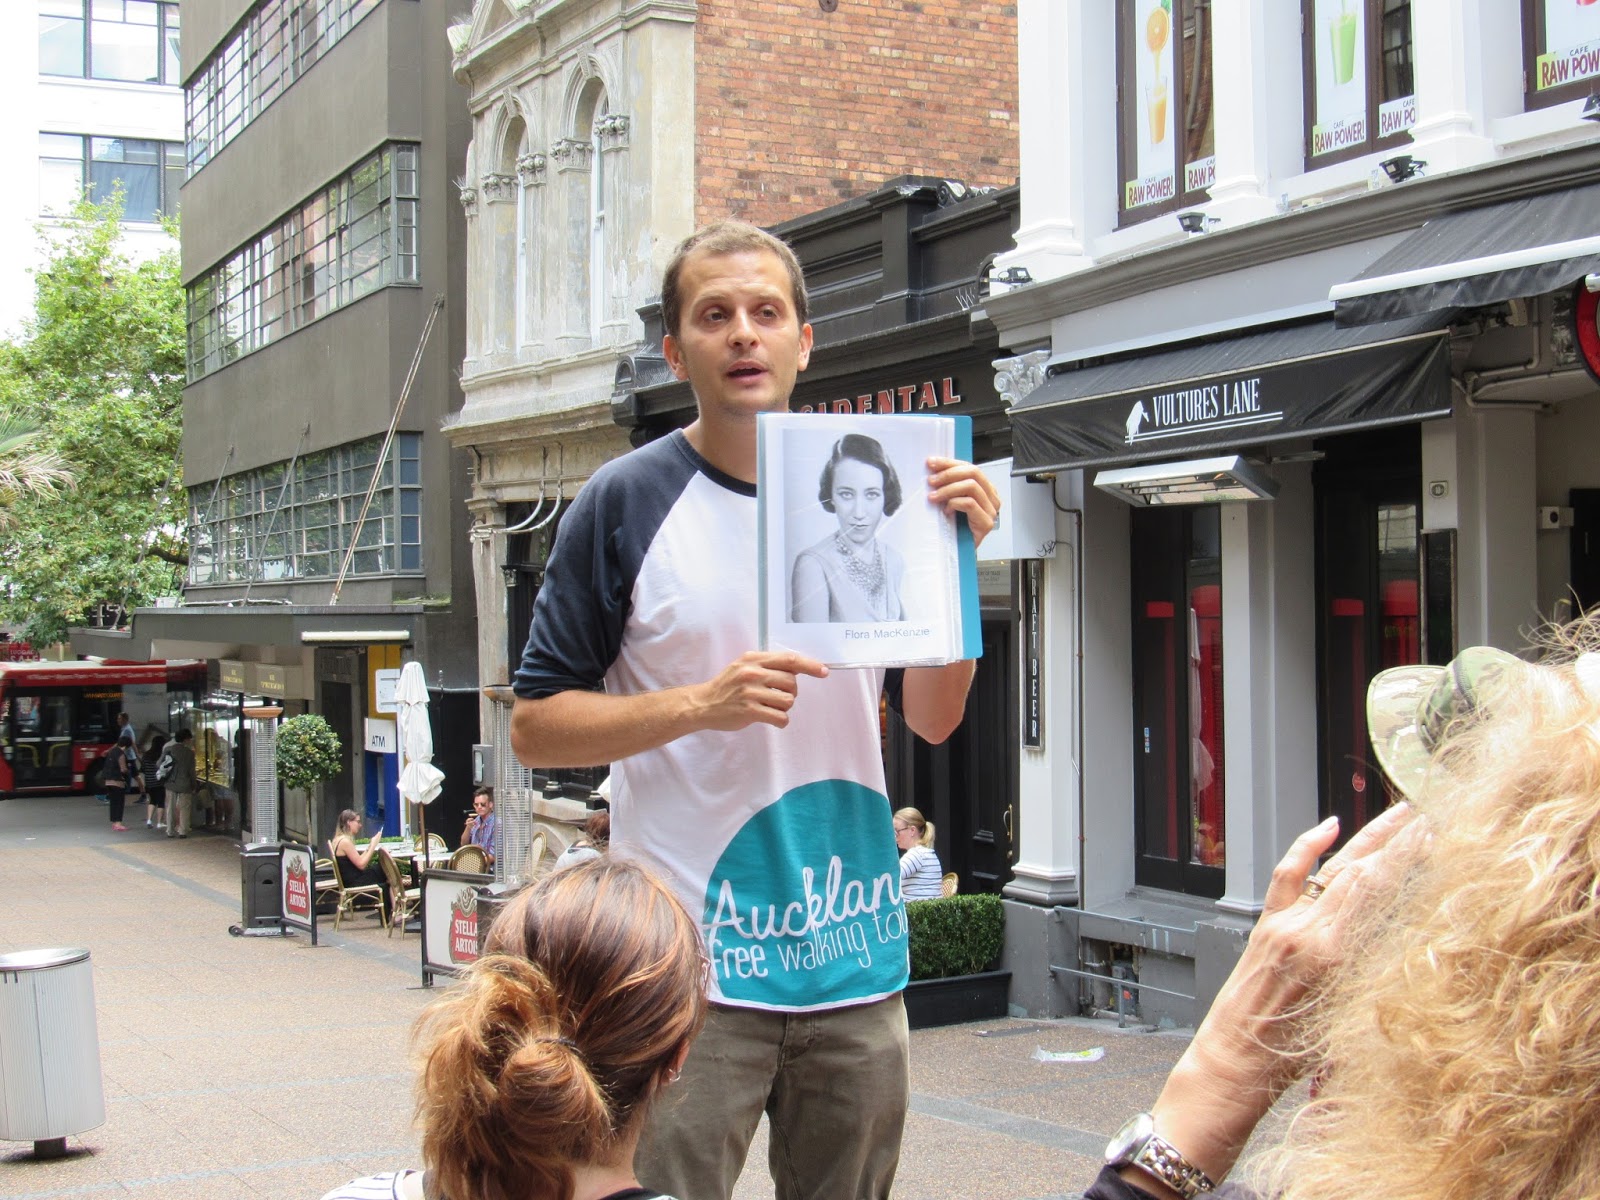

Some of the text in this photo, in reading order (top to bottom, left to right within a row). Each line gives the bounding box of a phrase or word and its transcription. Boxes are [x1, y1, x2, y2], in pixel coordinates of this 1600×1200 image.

[1570, 46, 1588, 56] CAFE
[1542, 48, 1600, 88] RAW POW
[1403, 98, 1415, 107] CAFE
[1333, 120, 1344, 129] CAFE
[1381, 110, 1402, 134] RAW
[1315, 119, 1365, 154] RAW POWER!
[1188, 166, 1207, 190] RAW
[1128, 175, 1173, 206] RAW POWER!
[1153, 378, 1261, 427] VULTURES LANE
[845, 627, 930, 639] Flora MacKenzie
[372, 735, 386, 748] ATM
[289, 879, 306, 895] STELLA
[702, 855, 901, 940] Aucklan
[289, 893, 307, 909] ARTOIS
[776, 920, 872, 972] walking
[872, 904, 908, 944] tou
